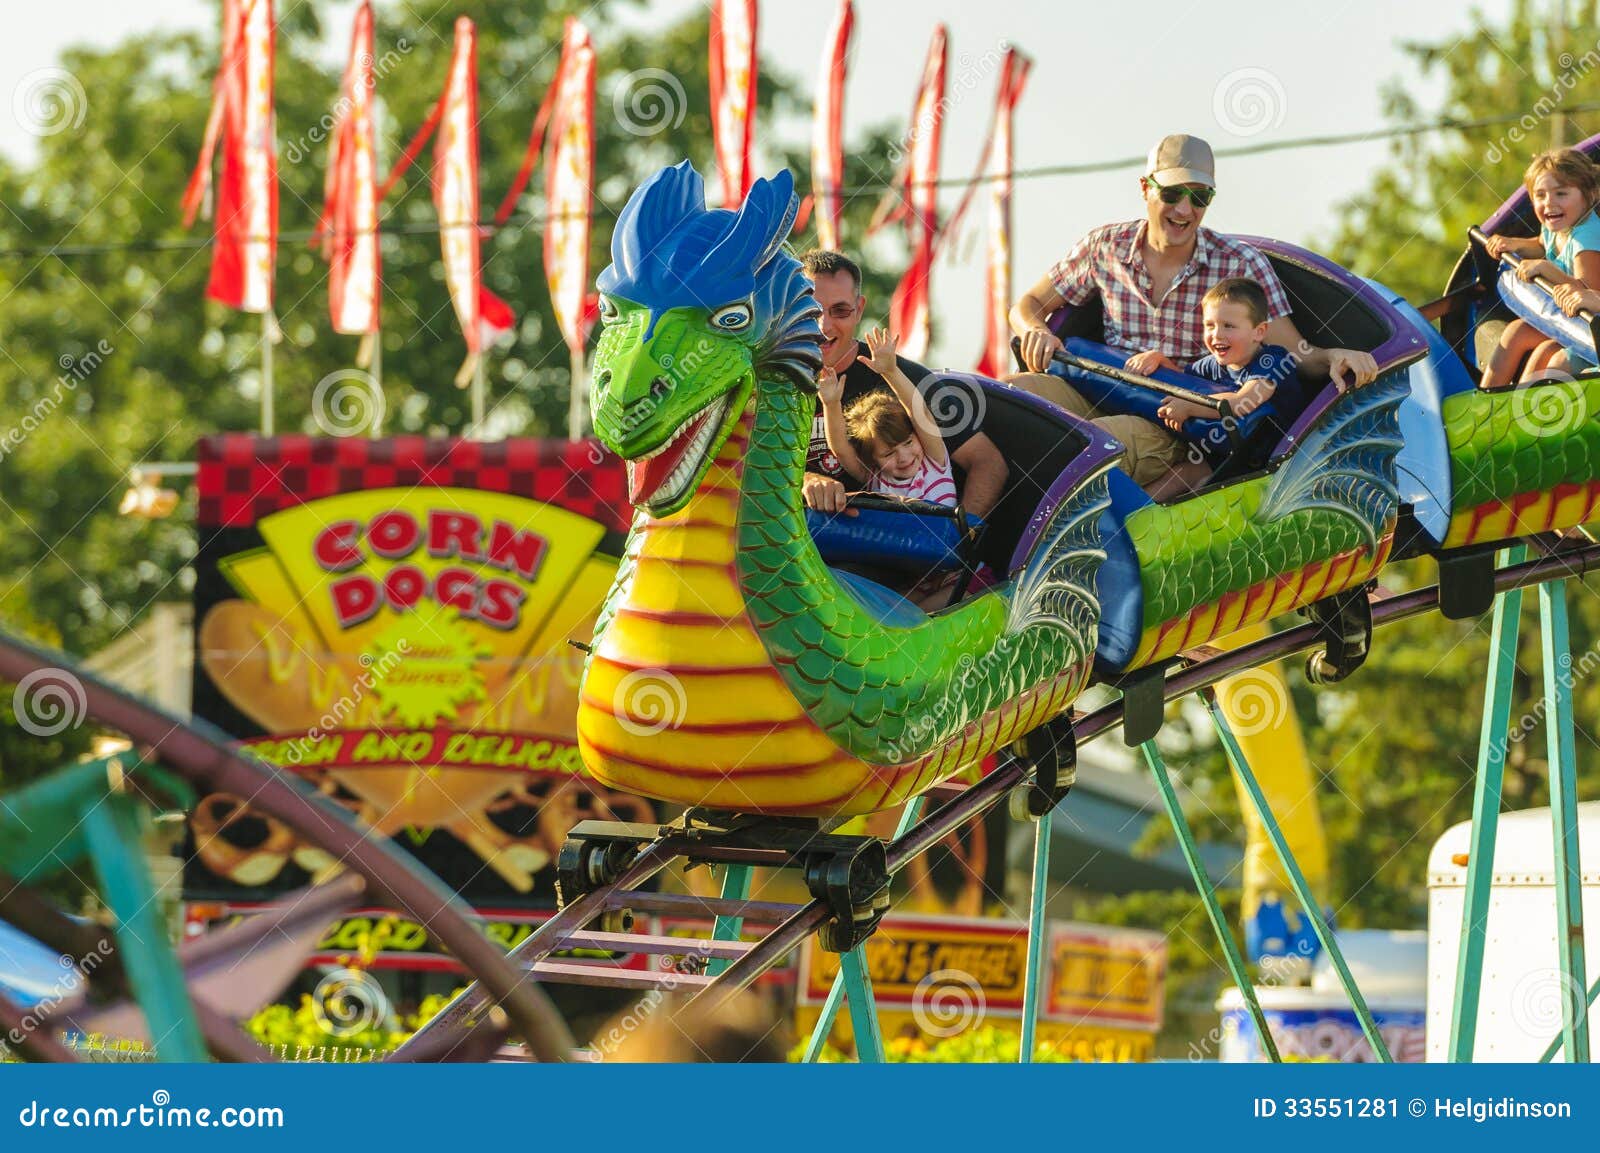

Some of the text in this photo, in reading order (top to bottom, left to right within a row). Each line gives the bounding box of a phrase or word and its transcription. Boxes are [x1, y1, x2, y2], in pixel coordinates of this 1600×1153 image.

[313, 510, 549, 582] CORN
[329, 563, 528, 631] DOGS
[351, 731, 431, 763] AND
